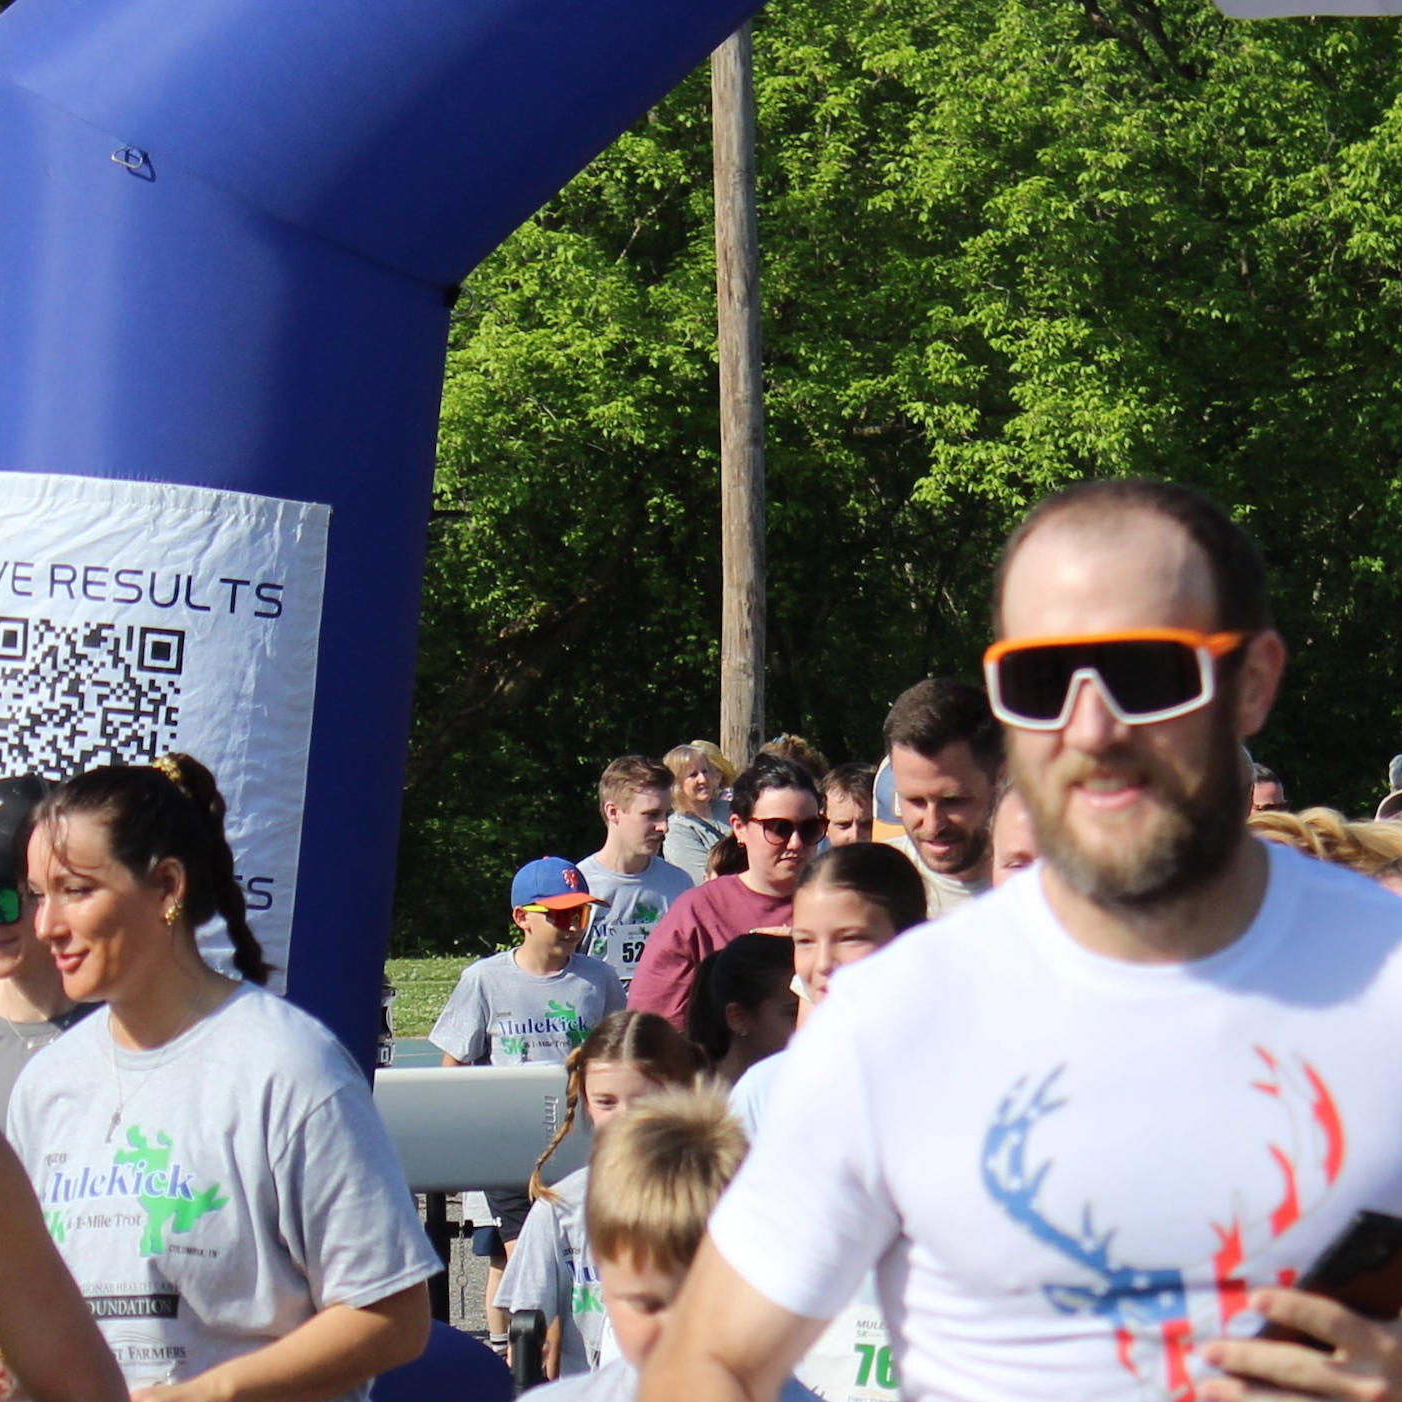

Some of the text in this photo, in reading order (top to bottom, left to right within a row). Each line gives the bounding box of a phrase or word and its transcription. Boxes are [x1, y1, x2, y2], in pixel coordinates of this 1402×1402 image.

[48, 563, 284, 619] RESULTS
[115, 1212, 142, 1228] Trot
[86, 1299, 173, 1316] OUNDATION
[128, 1346, 187, 1359] FARMERS
[854, 1343, 901, 1391] 76
